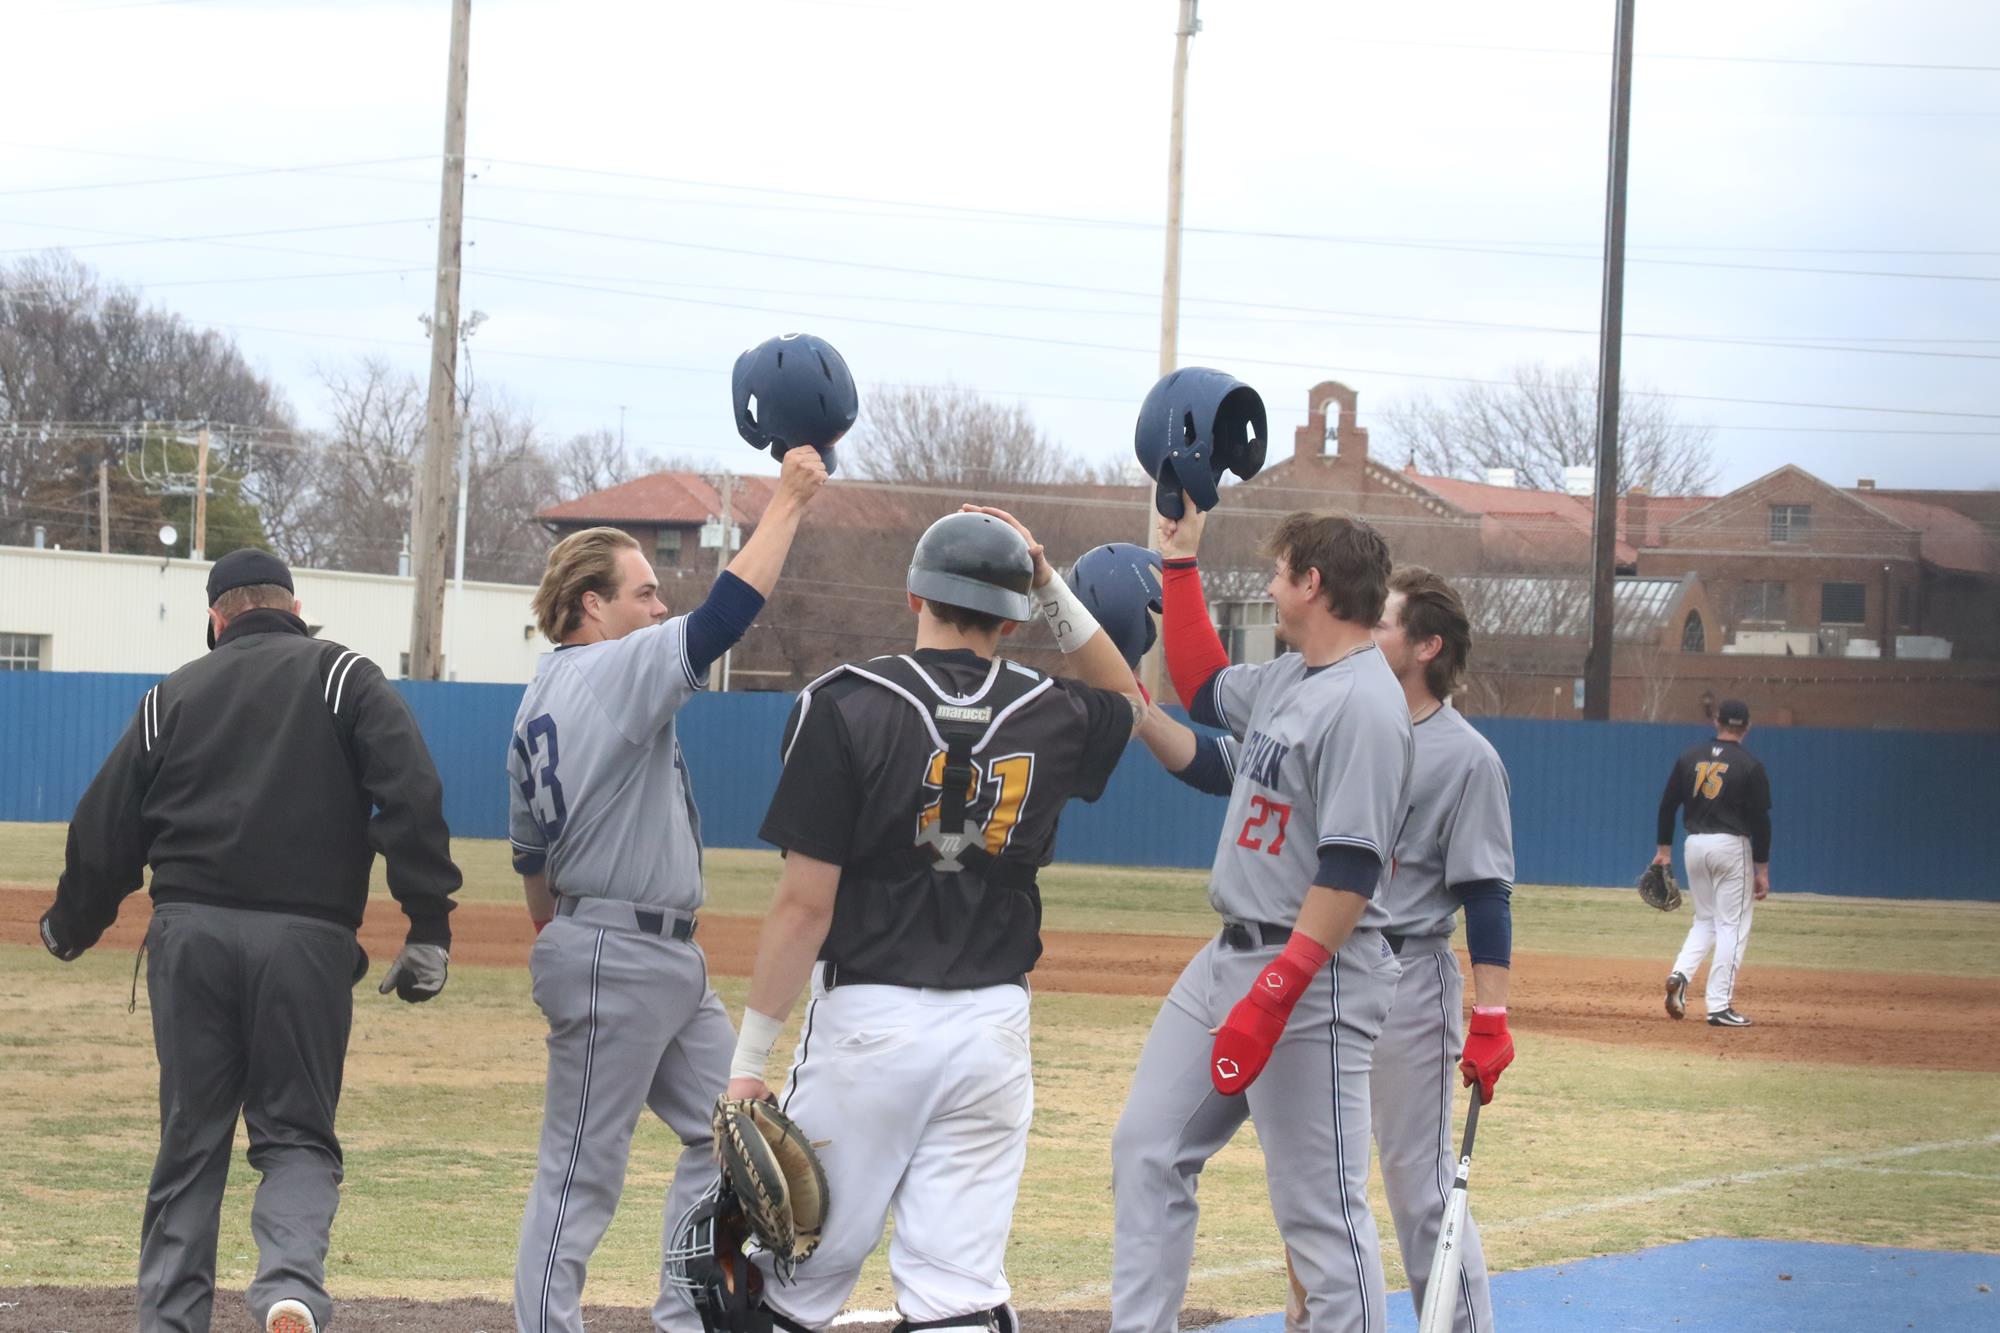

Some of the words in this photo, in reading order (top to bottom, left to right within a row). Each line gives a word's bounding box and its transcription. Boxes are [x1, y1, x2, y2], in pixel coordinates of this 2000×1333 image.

[936, 704, 992, 722] marucci
[1692, 761, 1729, 800] 15
[1236, 794, 1292, 856] 27
